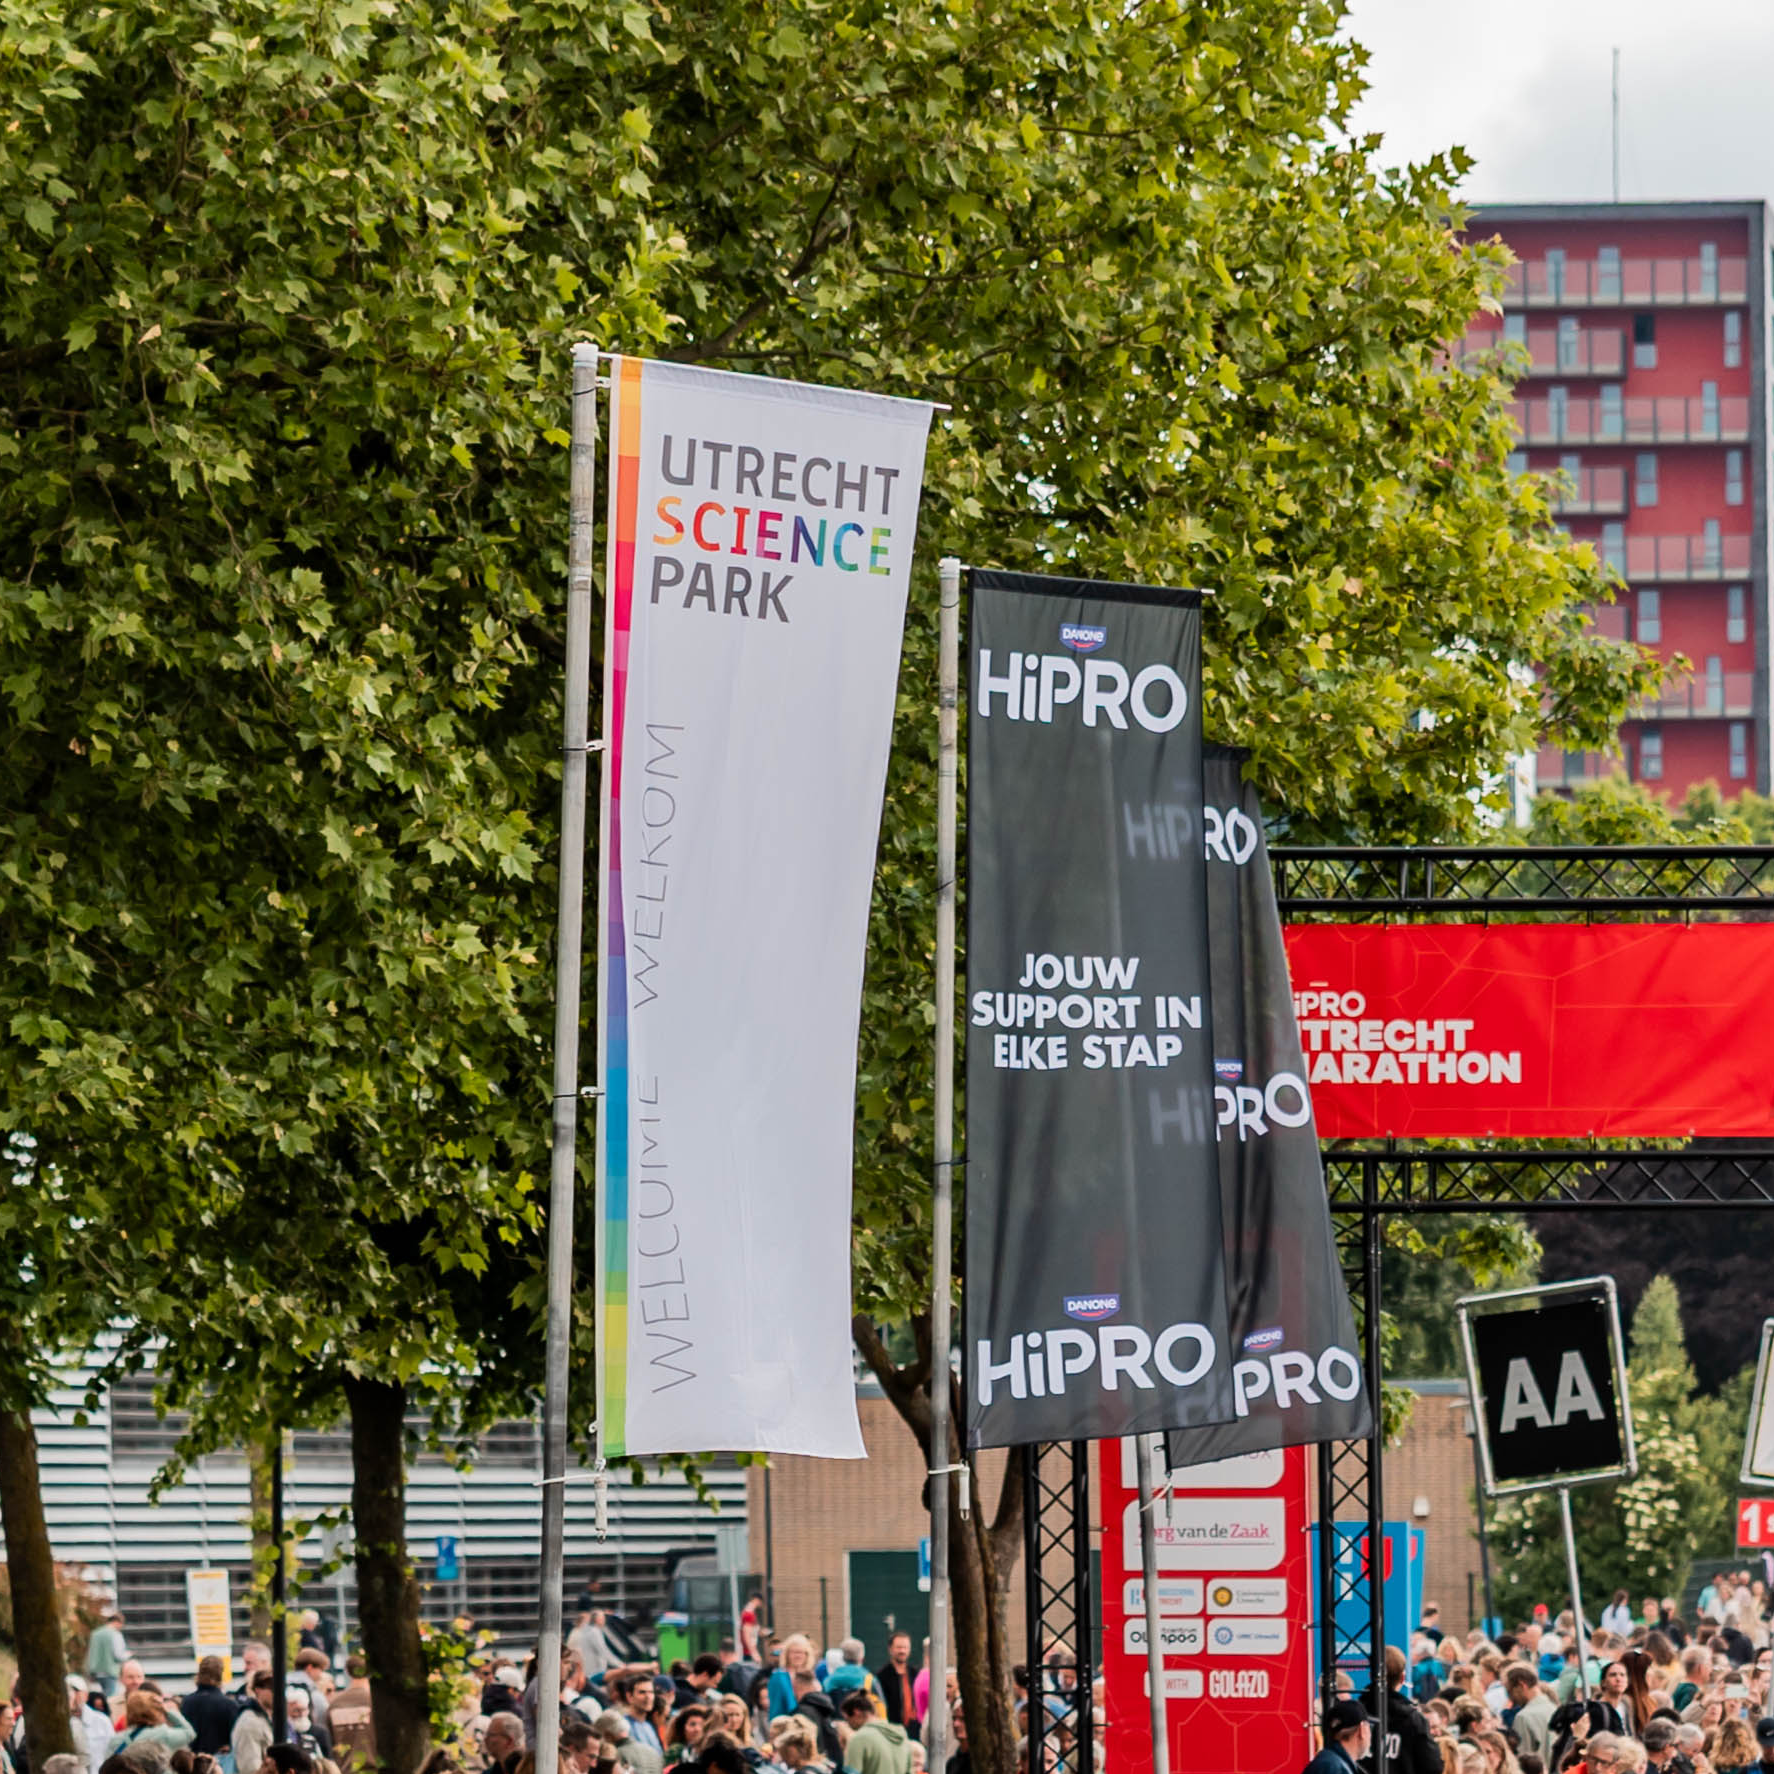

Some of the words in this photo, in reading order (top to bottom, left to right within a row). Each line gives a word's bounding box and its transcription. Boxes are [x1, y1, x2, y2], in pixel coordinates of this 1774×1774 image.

[660, 434, 900, 515] UTRECHT
[652, 495, 891, 577] SCIENCE
[650, 555, 794, 623] PARK
[977, 648, 1188, 733] HiPRO
[634, 723, 685, 1009] WELKOM
[1019, 953, 1140, 990] JOUW
[971, 992, 1141, 1029] SUPPORT
[1155, 996, 1202, 1029] IN
[994, 1034, 1068, 1070] ELKE
[1083, 1034, 1183, 1068] STAP
[1298, 1019, 1474, 1052] TRECHT
[1302, 1051, 1522, 1084] ARATHON
[977, 1321, 1216, 1406] HiPRO
[1500, 1350, 1606, 1433] AA
[1178, 1526, 1207, 1539] van
[1209, 1524, 1228, 1539] de
[1230, 1523, 1270, 1538] Zaak
[1742, 1503, 1760, 1543] 1
[1165, 1678, 1189, 1690] WITH
[1208, 1670, 1269, 1698] GOLAZO
